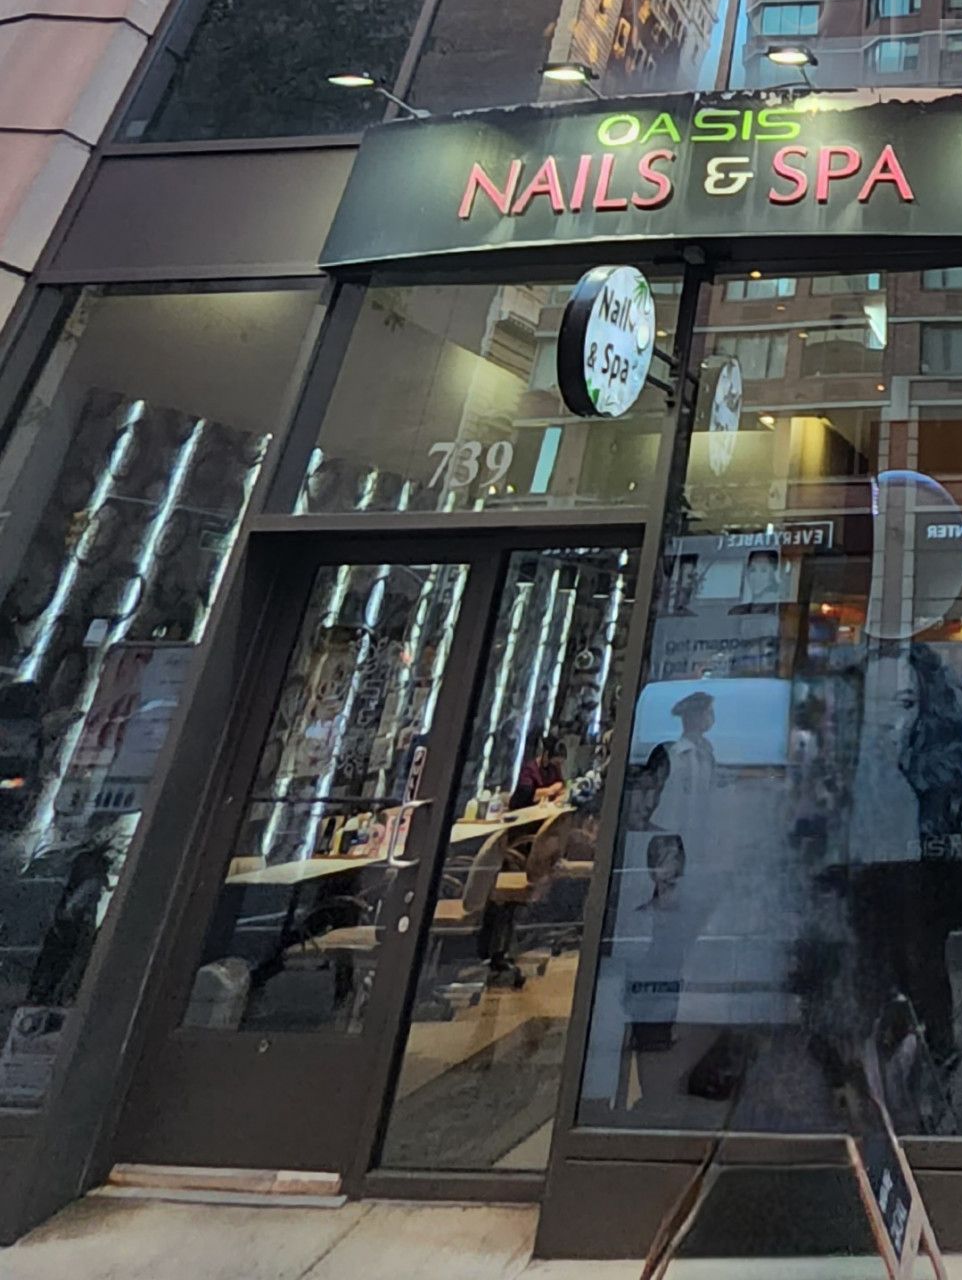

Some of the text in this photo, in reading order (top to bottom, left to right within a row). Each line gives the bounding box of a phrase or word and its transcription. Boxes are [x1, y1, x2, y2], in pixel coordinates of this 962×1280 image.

[596, 108, 802, 147] OASIS
[458, 144, 915, 219] NAILS & SPA
[586, 341, 630, 388] & Spa
[427, 440, 514, 489] 739
